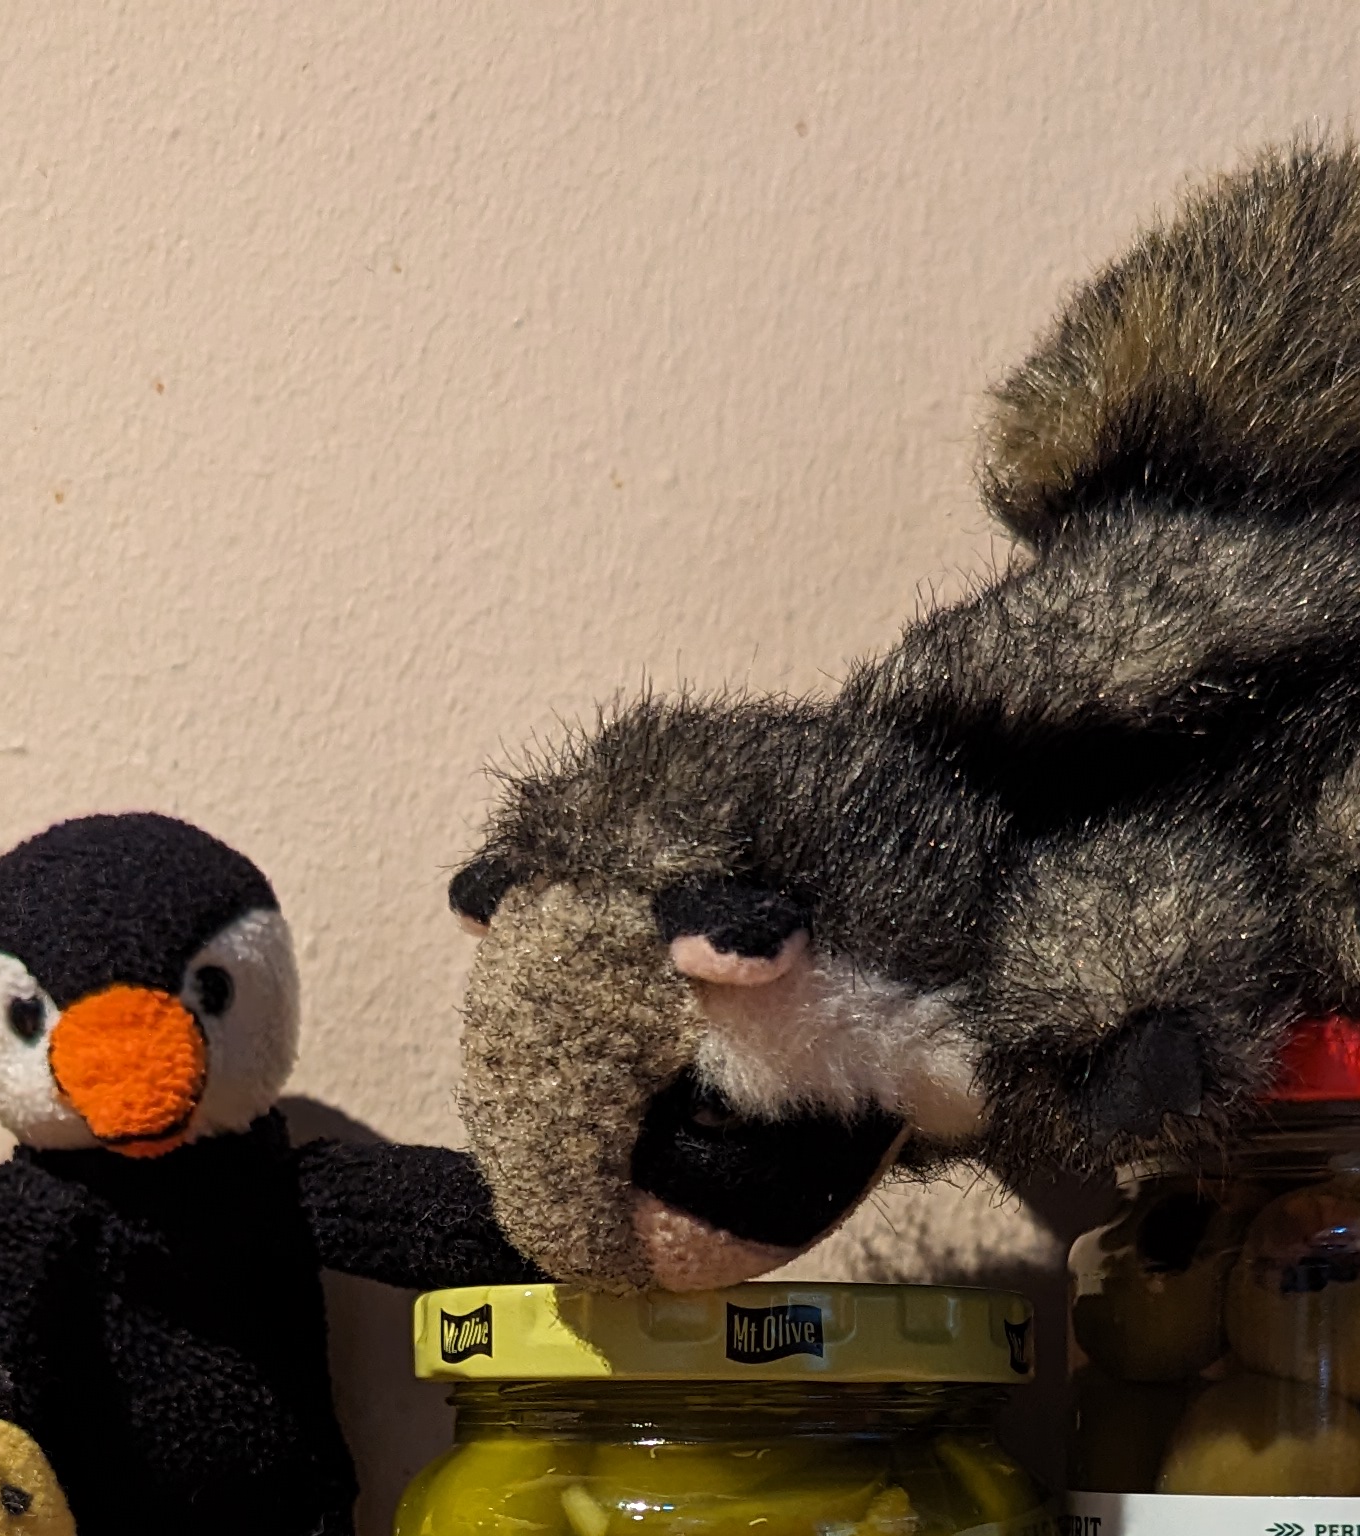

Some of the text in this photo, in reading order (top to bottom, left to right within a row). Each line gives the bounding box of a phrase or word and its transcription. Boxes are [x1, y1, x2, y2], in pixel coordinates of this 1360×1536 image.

[457, 1317, 489, 1352] Olive
[733, 1313, 815, 1353] Mt. Olive
